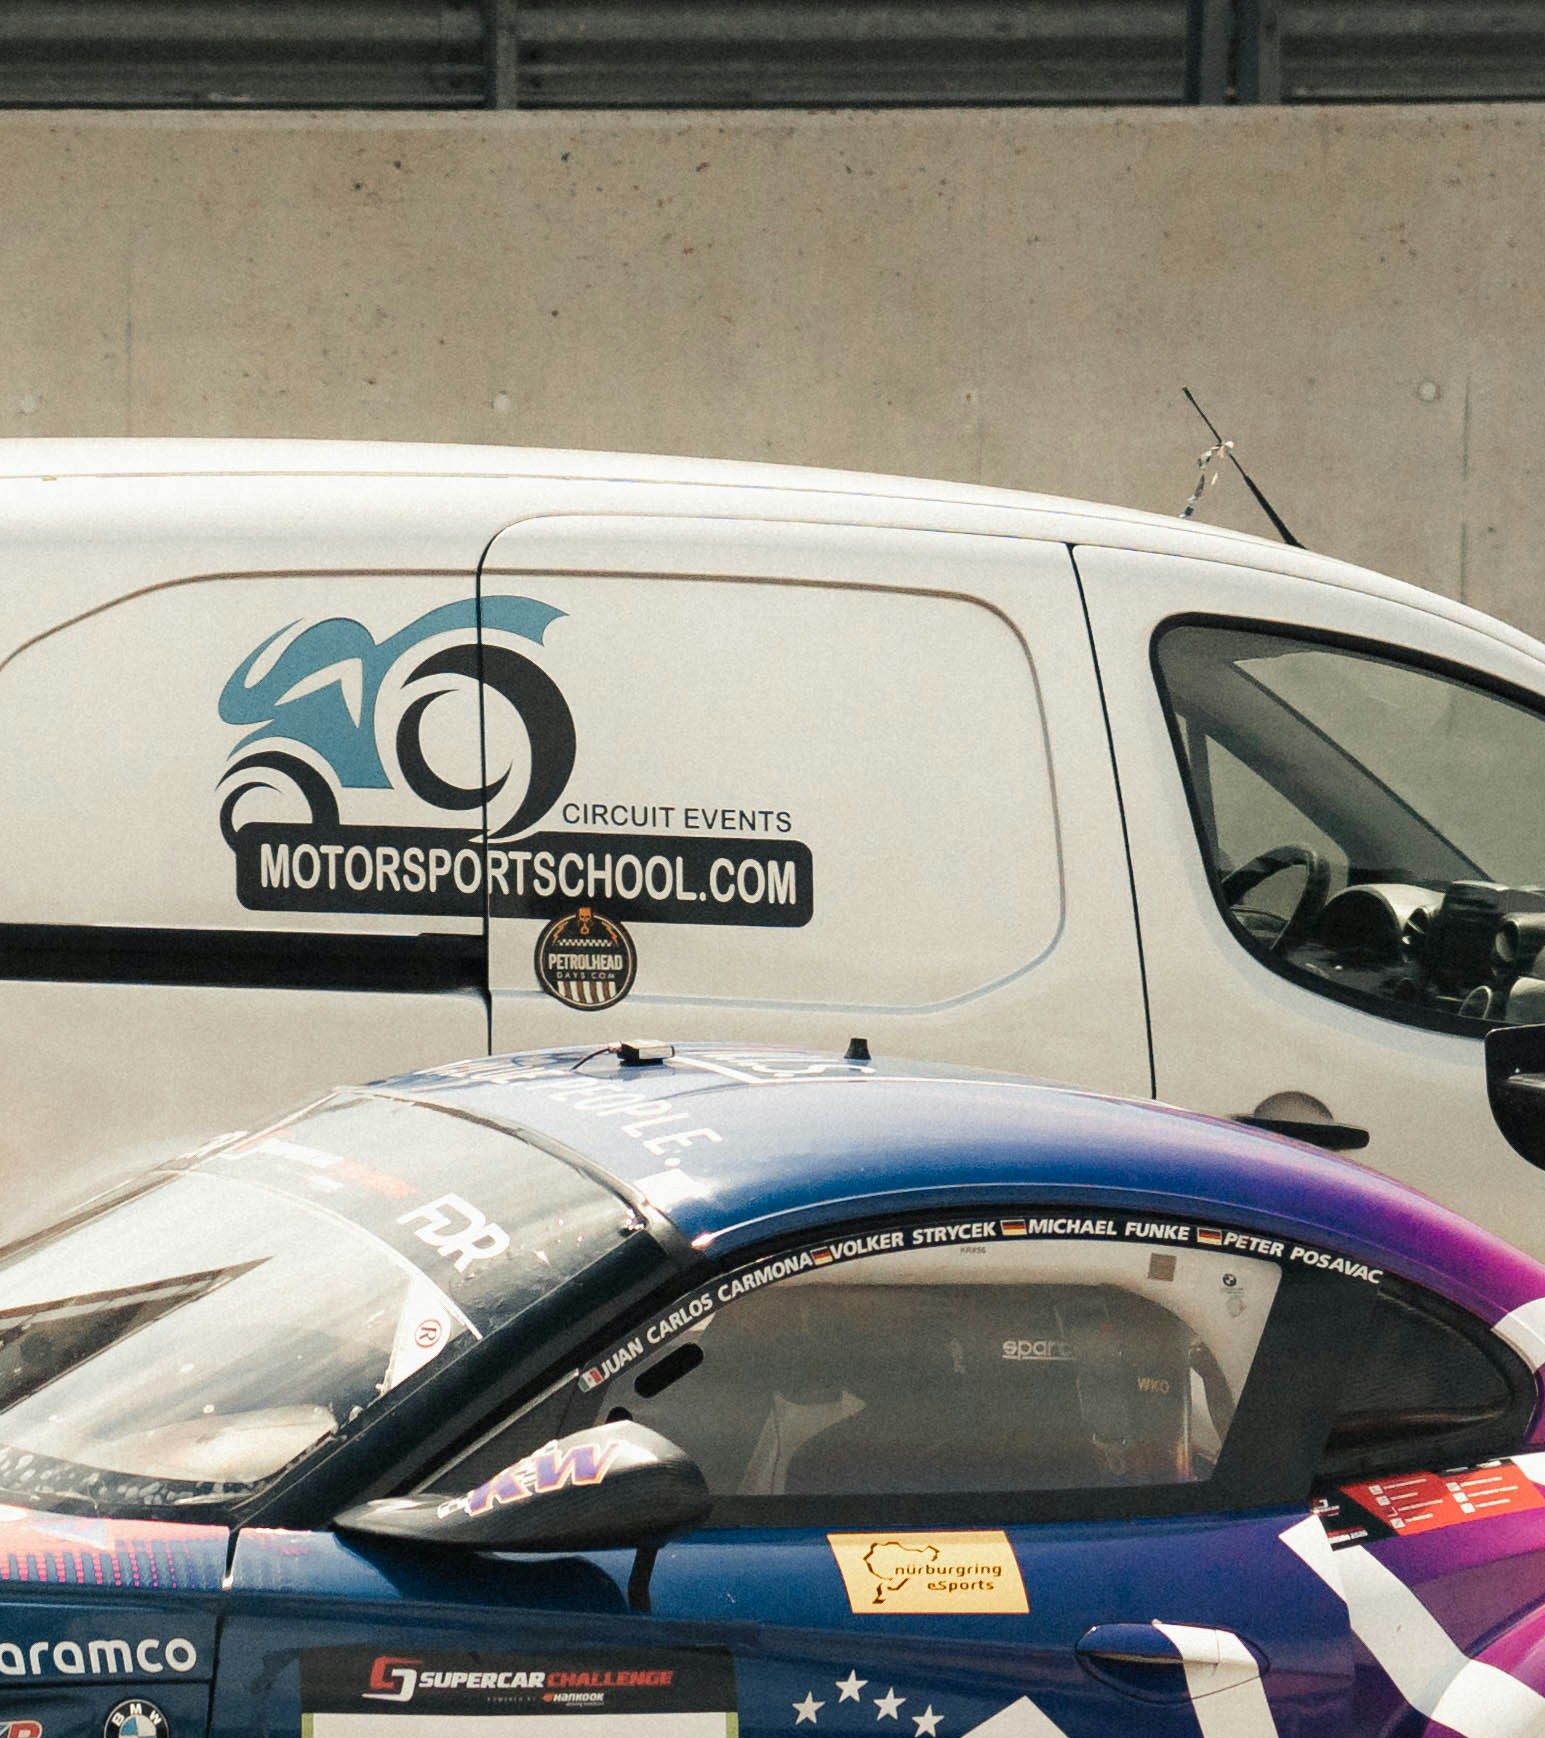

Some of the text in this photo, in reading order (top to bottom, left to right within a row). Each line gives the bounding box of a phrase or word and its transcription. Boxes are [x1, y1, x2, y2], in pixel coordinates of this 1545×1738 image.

[563, 802, 792, 833] CIRCUIT EVENTS
[260, 843, 797, 905] MOTORSPORTSCHOOL.COM
[547, 951, 624, 973] PETROLHEAD
[829, 1220, 997, 1264] VOLKER STRYCEK
[1028, 1218, 1190, 1241] MICHAEL FUNKE
[1223, 1232, 1384, 1285] PETER POSAVAC
[600, 1251, 814, 1381] JUAN CARLOS CARMONA
[895, 1560, 1003, 1580] nürburgring
[418, 1669, 674, 1689] SUPERCAR CHALLENGE
[111, 1702, 165, 1728] BMW
